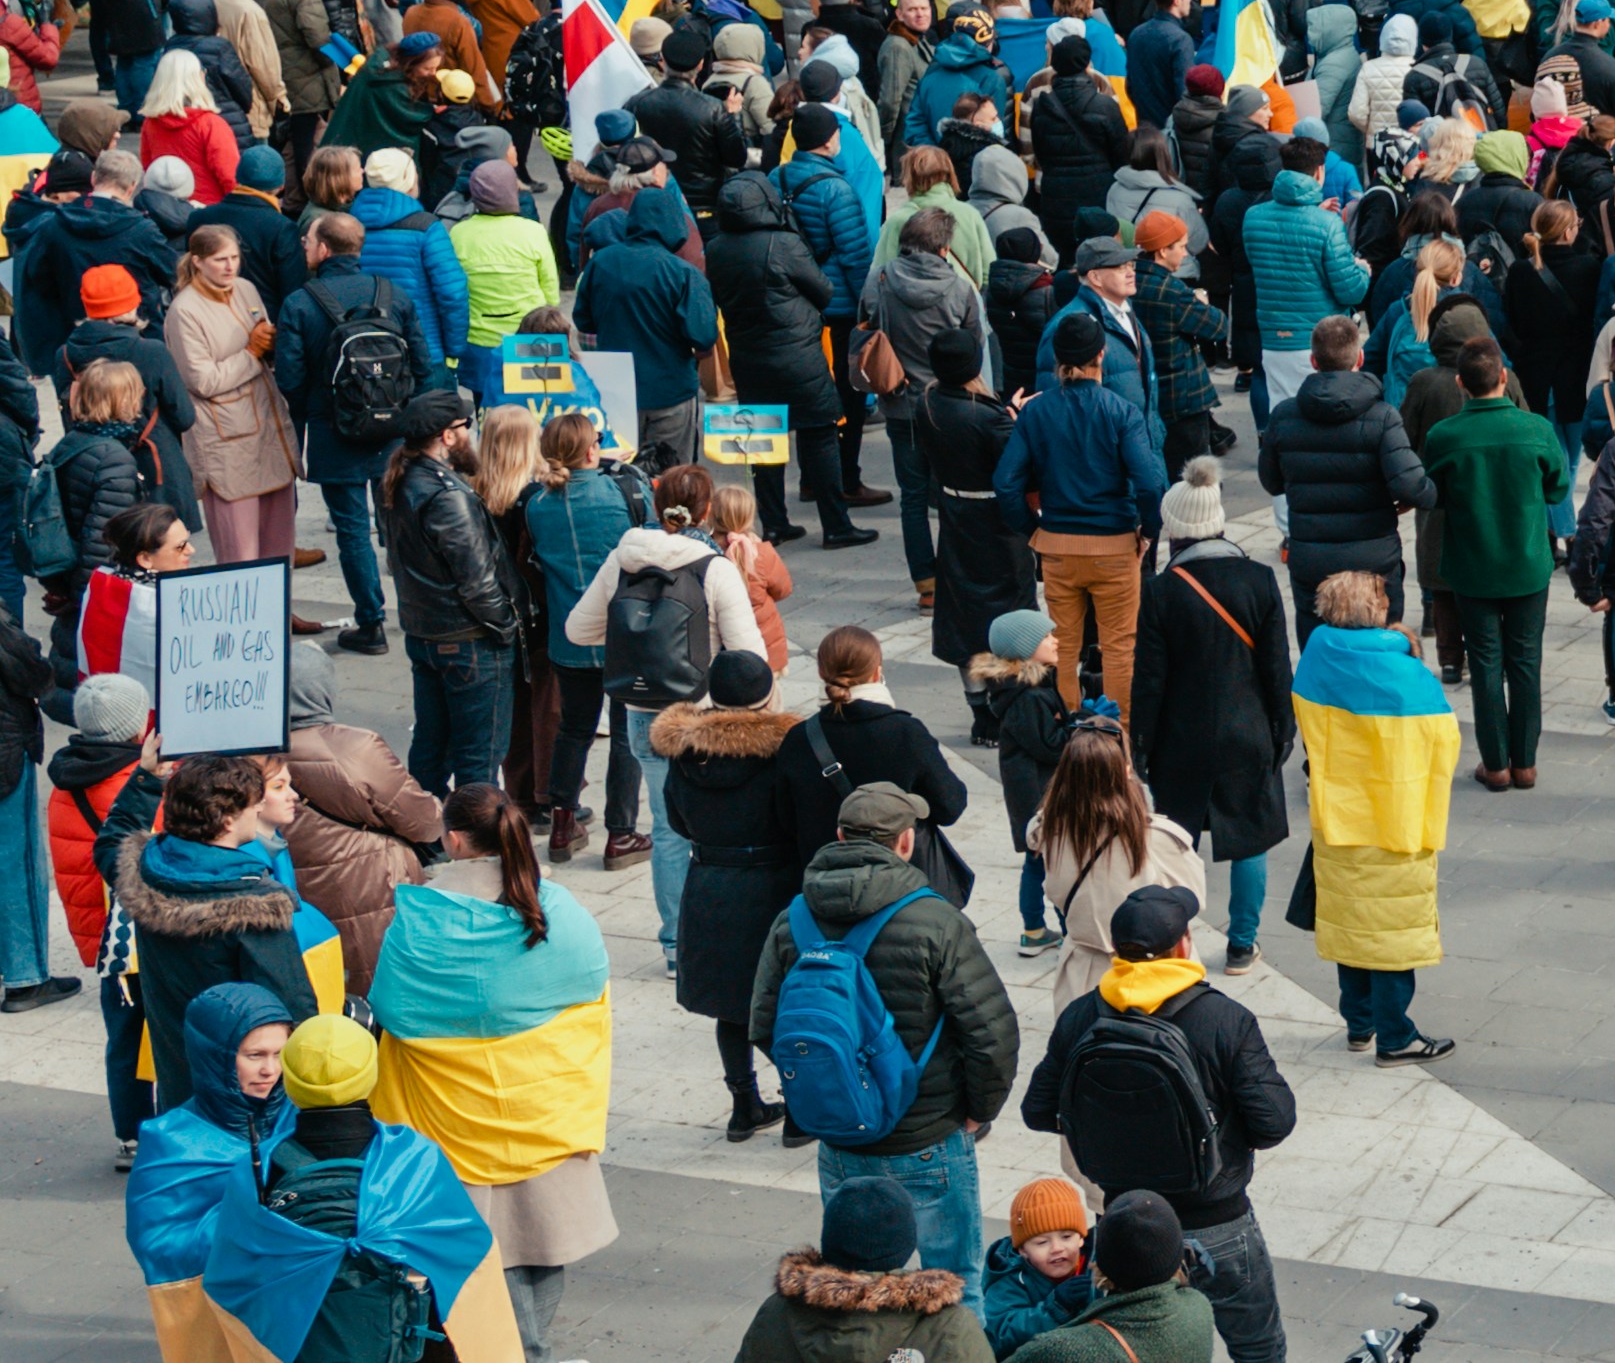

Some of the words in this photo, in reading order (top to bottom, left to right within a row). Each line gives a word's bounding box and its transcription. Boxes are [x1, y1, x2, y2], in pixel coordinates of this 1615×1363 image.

[179, 576, 260, 628] RUSSIAN
[169, 634, 202, 675] OIL
[212, 631, 235, 662] AND
[241, 629, 274, 663] GAS
[185, 670, 269, 714] EMBARGO!!!
